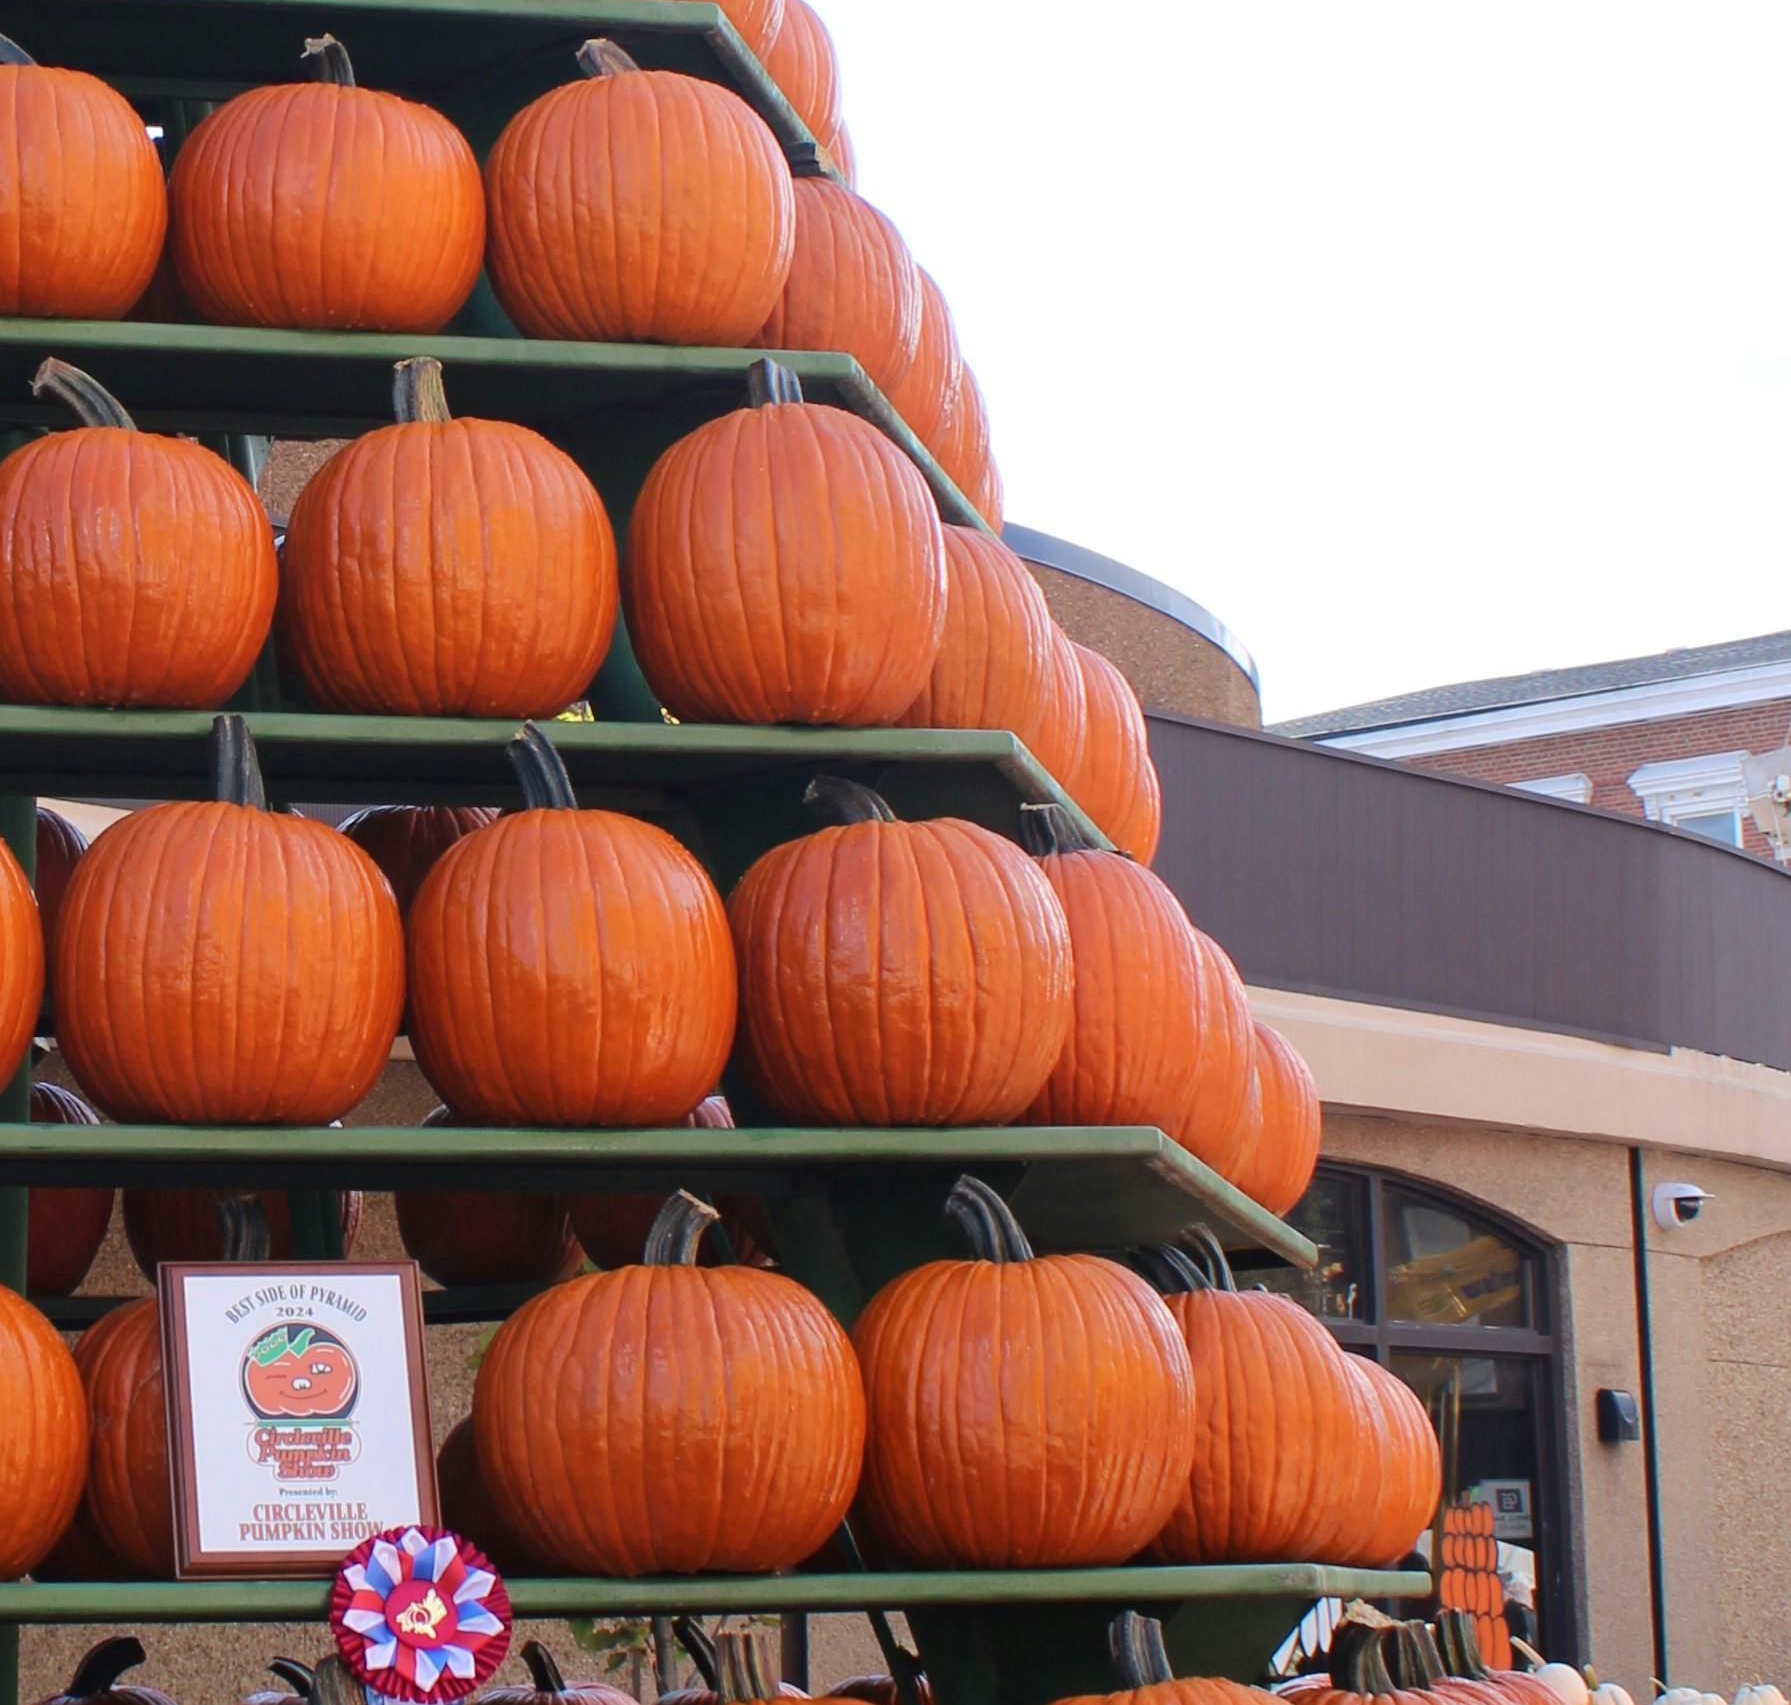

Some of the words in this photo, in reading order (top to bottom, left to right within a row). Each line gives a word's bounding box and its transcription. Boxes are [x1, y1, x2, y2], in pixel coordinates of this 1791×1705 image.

[225, 1297, 256, 1325] BEST
[255, 1288, 287, 1307] SIDE
[289, 1284, 307, 1300] OF
[310, 1285, 368, 1323] PYRAMID
[276, 1306, 315, 1317] 2024
[255, 1425, 353, 1446] Circleville
[258, 1444, 351, 1463] Pumpkin
[277, 1460, 336, 1479] Show
[279, 1487, 323, 1496] Presented
[253, 1503, 368, 1522] CIRCLEVILLE
[239, 1522, 325, 1541] PUMPKIN
[331, 1521, 384, 1540] SHOW
